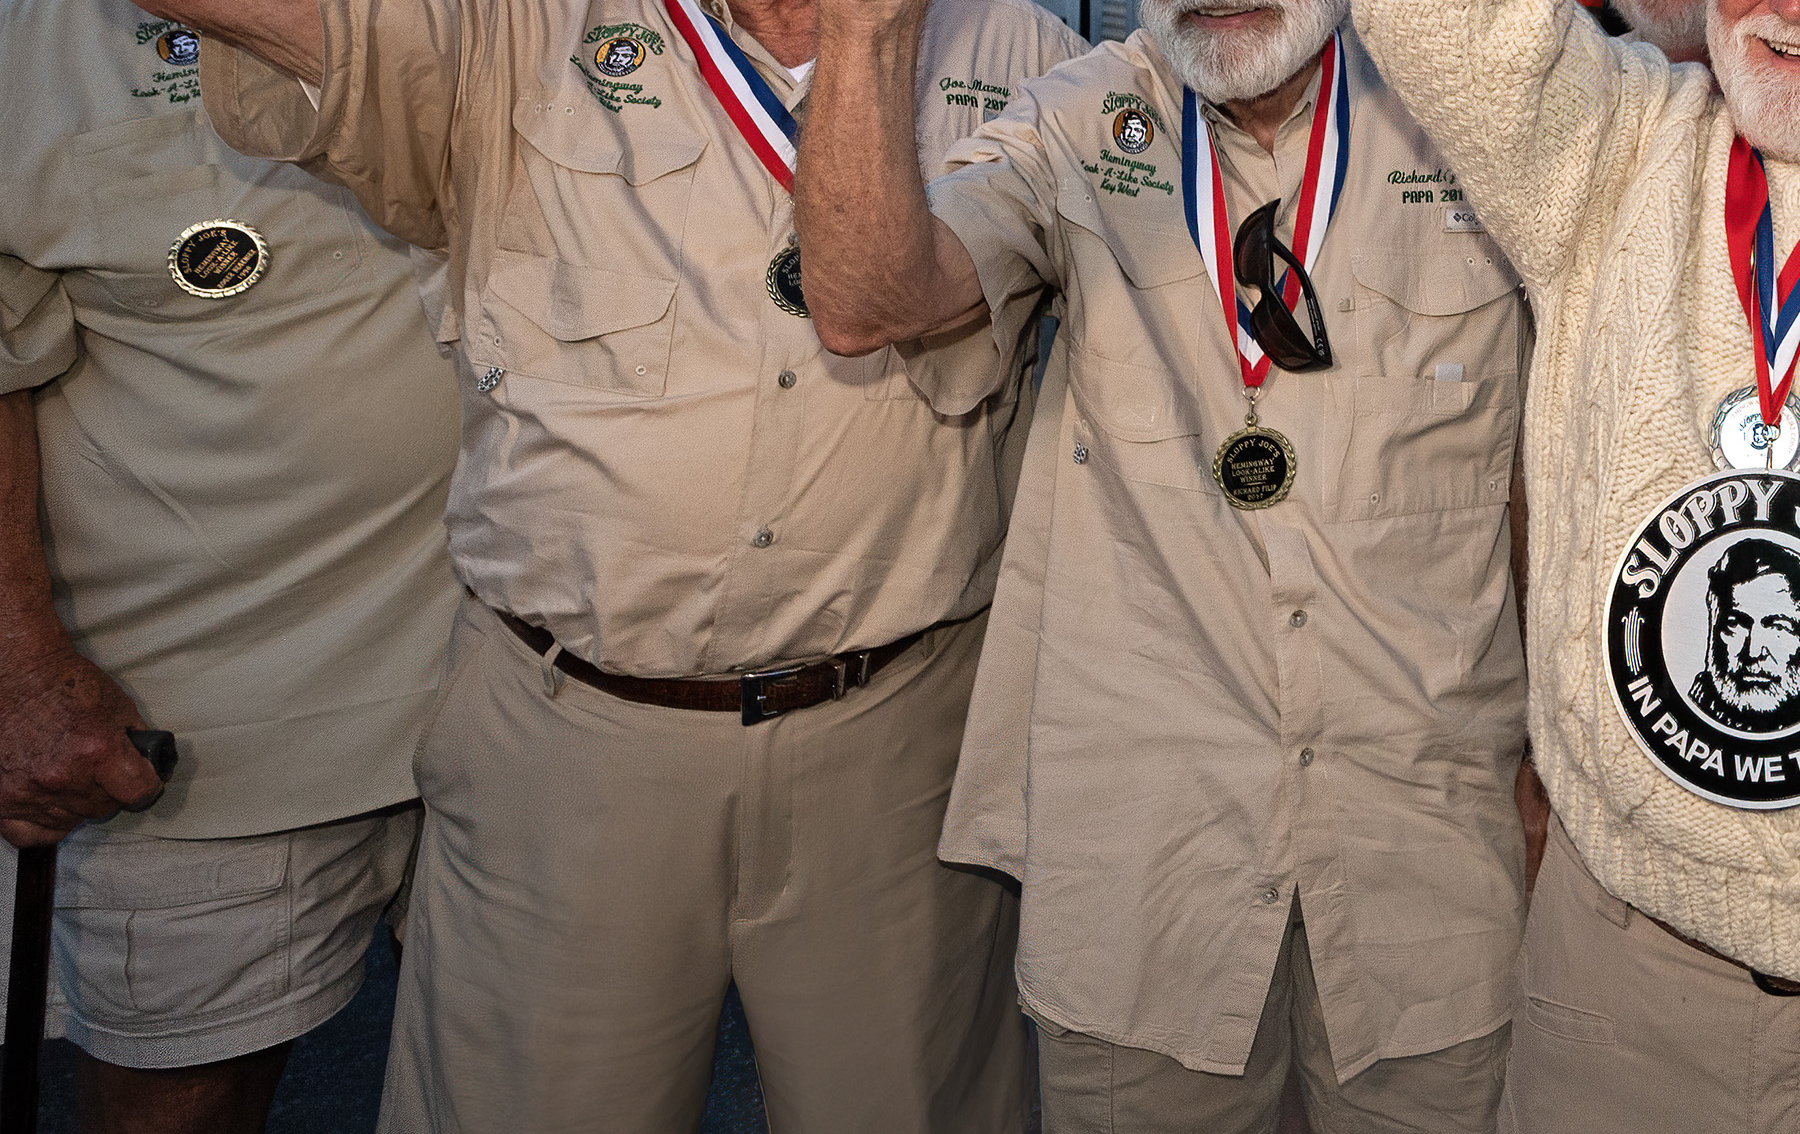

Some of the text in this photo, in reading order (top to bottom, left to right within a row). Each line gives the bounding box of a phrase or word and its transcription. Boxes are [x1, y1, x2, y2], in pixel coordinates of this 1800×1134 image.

[939, 77, 966, 92] Joe
[623, 94, 662, 109] Society
[946, 93, 979, 109] PAPA
[1101, 95, 1142, 115] SLOPPY
[1099, 148, 1157, 177] Hemingway
[1140, 176, 1174, 196] Society
[1387, 168, 1442, 185] Richard
[1100, 177, 1140, 198] Key West
[1402, 188, 1464, 204] PAPA 201
[181, 239, 197, 275] SLOPPY
[1226, 438, 1281, 464] SLOPPY JOE'S
[1231, 457, 1275, 469] HEMINGWAY
[1240, 473, 1267, 483] WINNER
[1621, 478, 1787, 600] SLOPPY
[1627, 674, 1663, 718] IN
[1651, 714, 1725, 777] PAPA
[1734, 754, 1786, 783] WE
